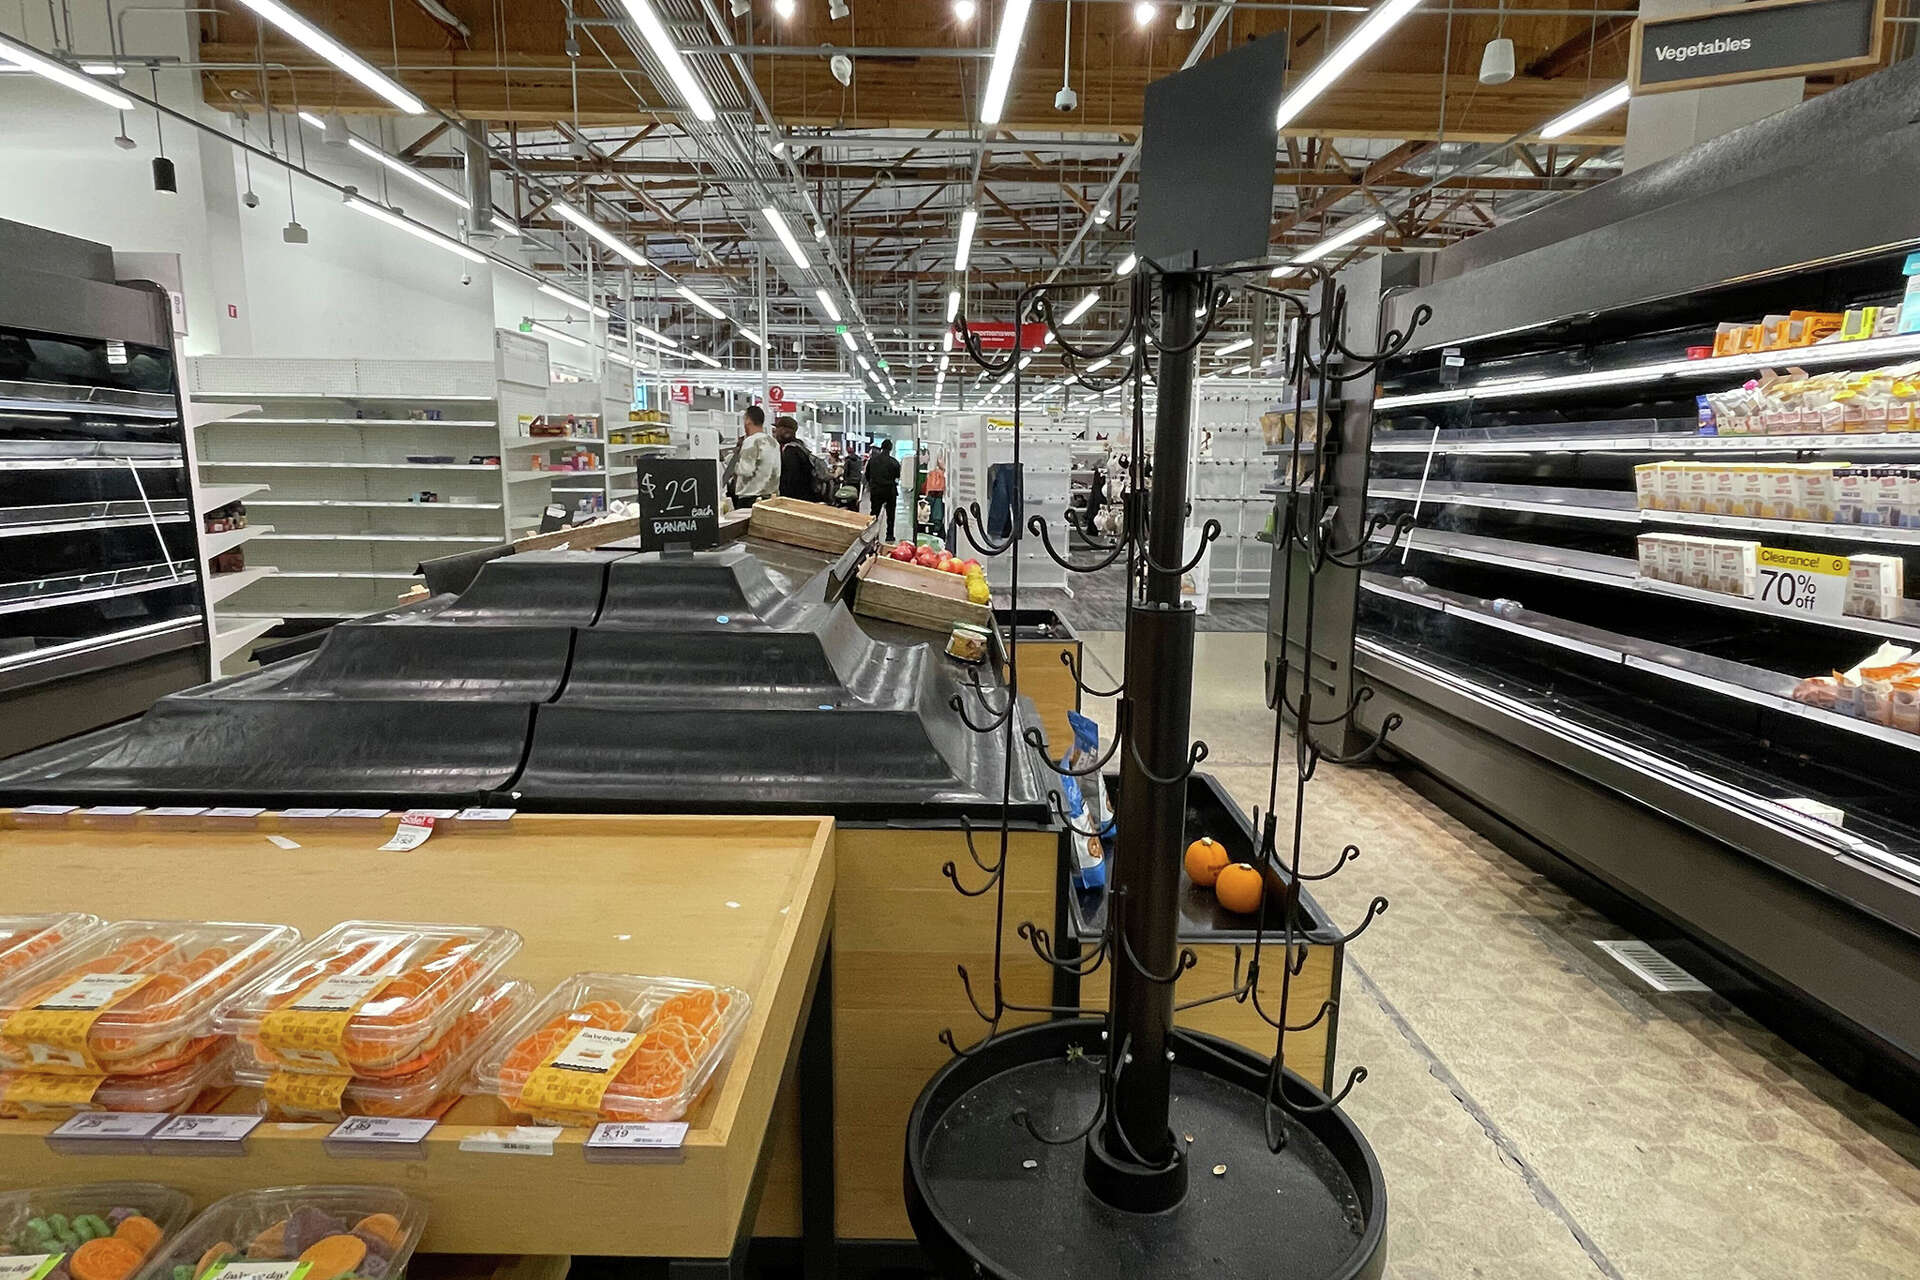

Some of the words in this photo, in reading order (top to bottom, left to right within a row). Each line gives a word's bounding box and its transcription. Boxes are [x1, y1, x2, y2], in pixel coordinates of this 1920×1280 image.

[1655, 37, 1751, 62] Vegetables
[653, 520, 697, 535] BANANA
[1761, 550, 1820, 568] Clearance!
[1795, 595, 1816, 610] off
